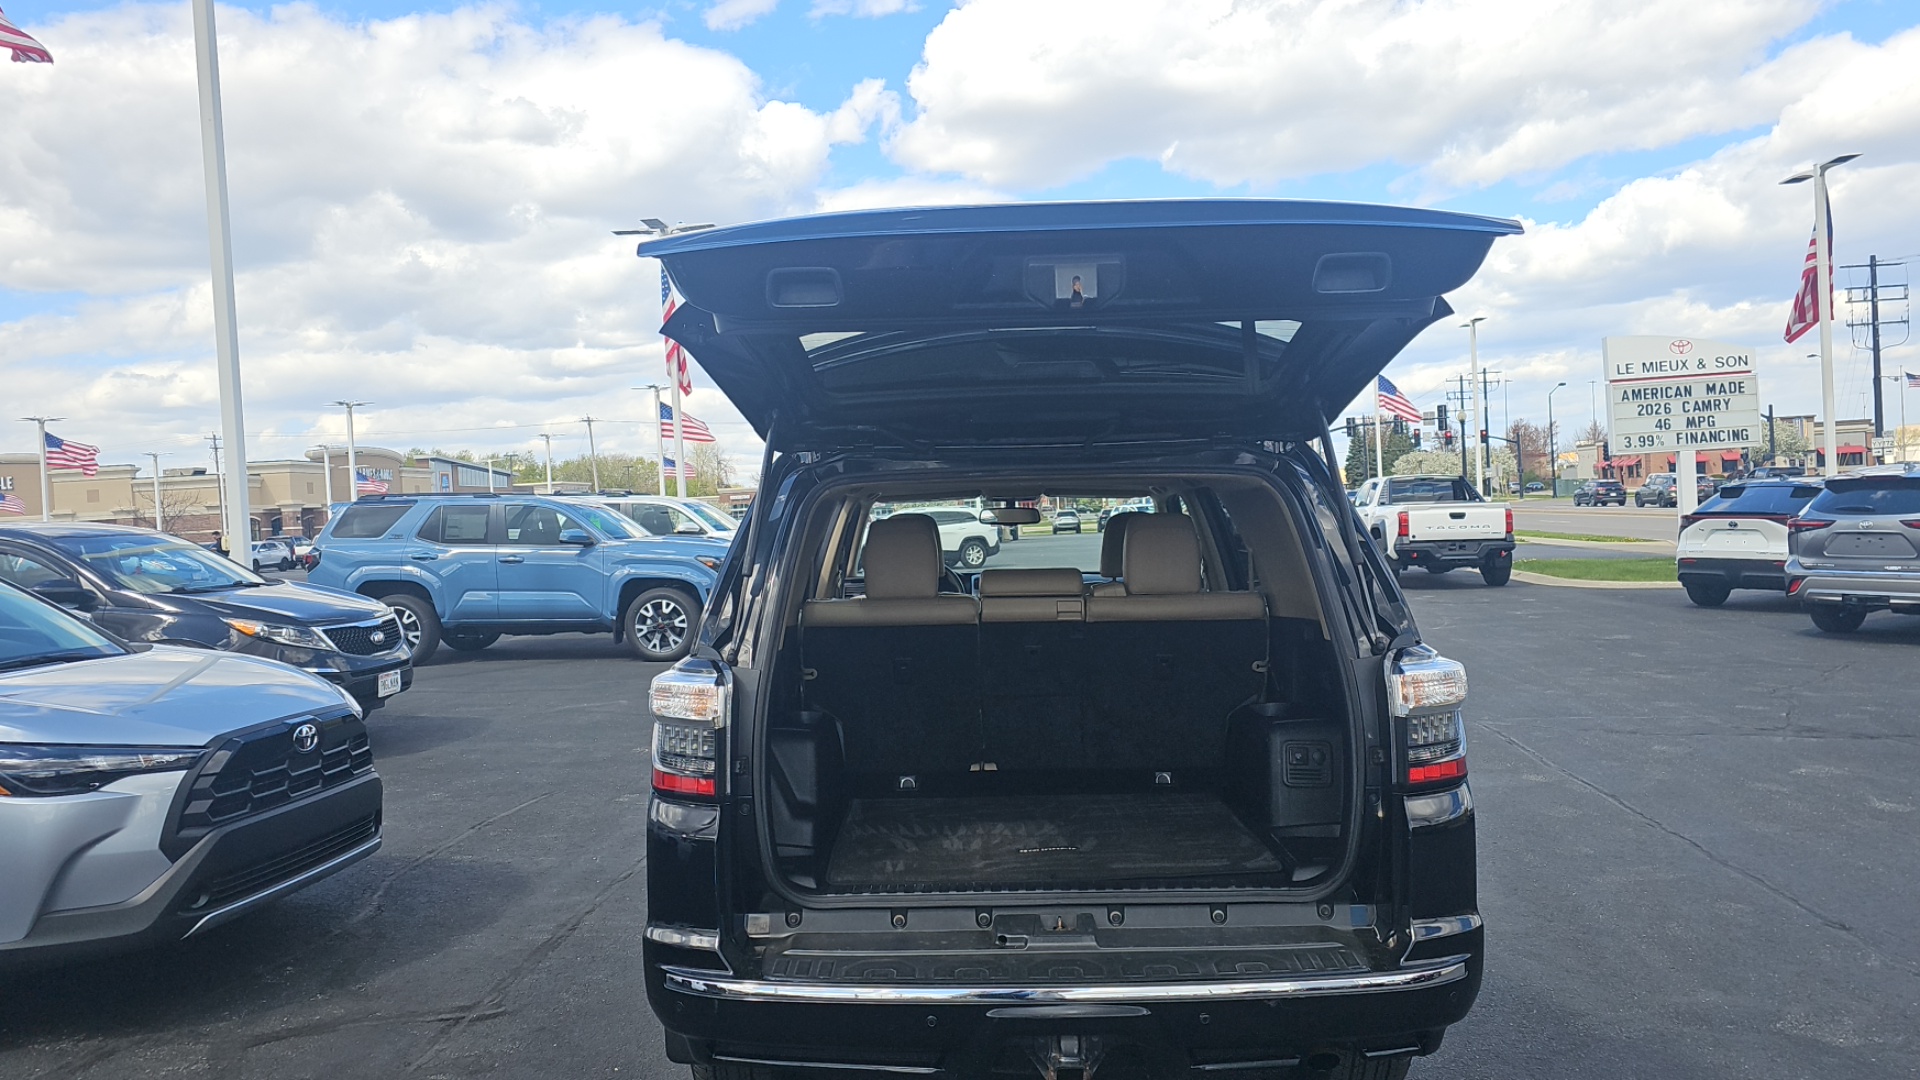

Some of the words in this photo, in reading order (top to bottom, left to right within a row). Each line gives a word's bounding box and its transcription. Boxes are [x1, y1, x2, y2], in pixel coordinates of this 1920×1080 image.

[1616, 363, 1635, 375] LE
[1642, 359, 1689, 373] MIEUX
[1697, 358, 1706, 369] &
[1715, 355, 1748, 368] SON
[1621, 385, 1692, 401] AMERICAN
[1706, 381, 1745, 395] MADE
[1637, 402, 1672, 416] 2026
[1682, 398, 1731, 413] CAMRY
[1655, 418, 1671, 430] 46
[1686, 415, 1716, 429] MPG
[1624, 434, 1665, 448] 3.99%
[1676, 428, 1749, 445] FINANCING
